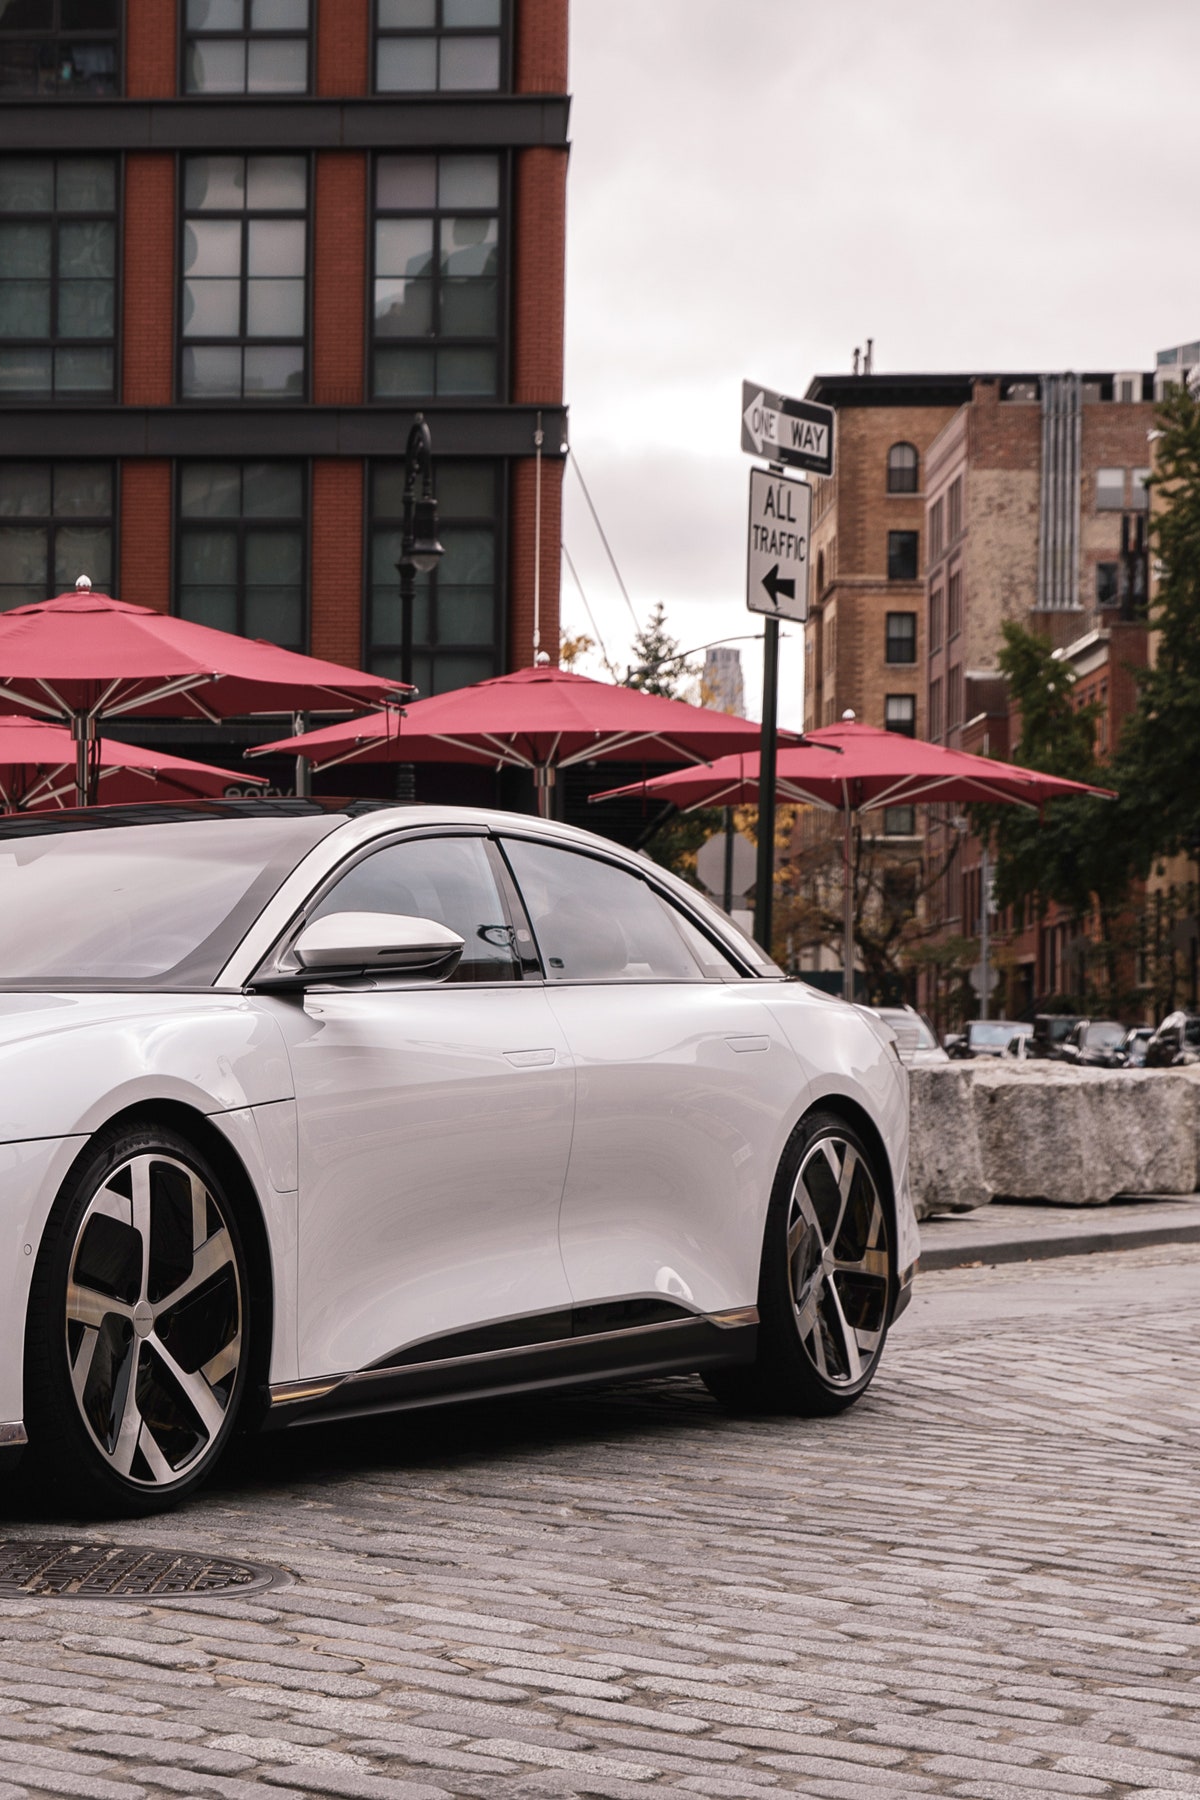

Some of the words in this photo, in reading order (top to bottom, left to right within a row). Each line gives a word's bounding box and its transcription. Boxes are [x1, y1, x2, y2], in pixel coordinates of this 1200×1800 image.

[752, 407, 776, 440] ONE
[790, 420, 825, 453] WAY
[763, 484, 797, 524] ALL
[753, 524, 806, 562] TRAFFIC
